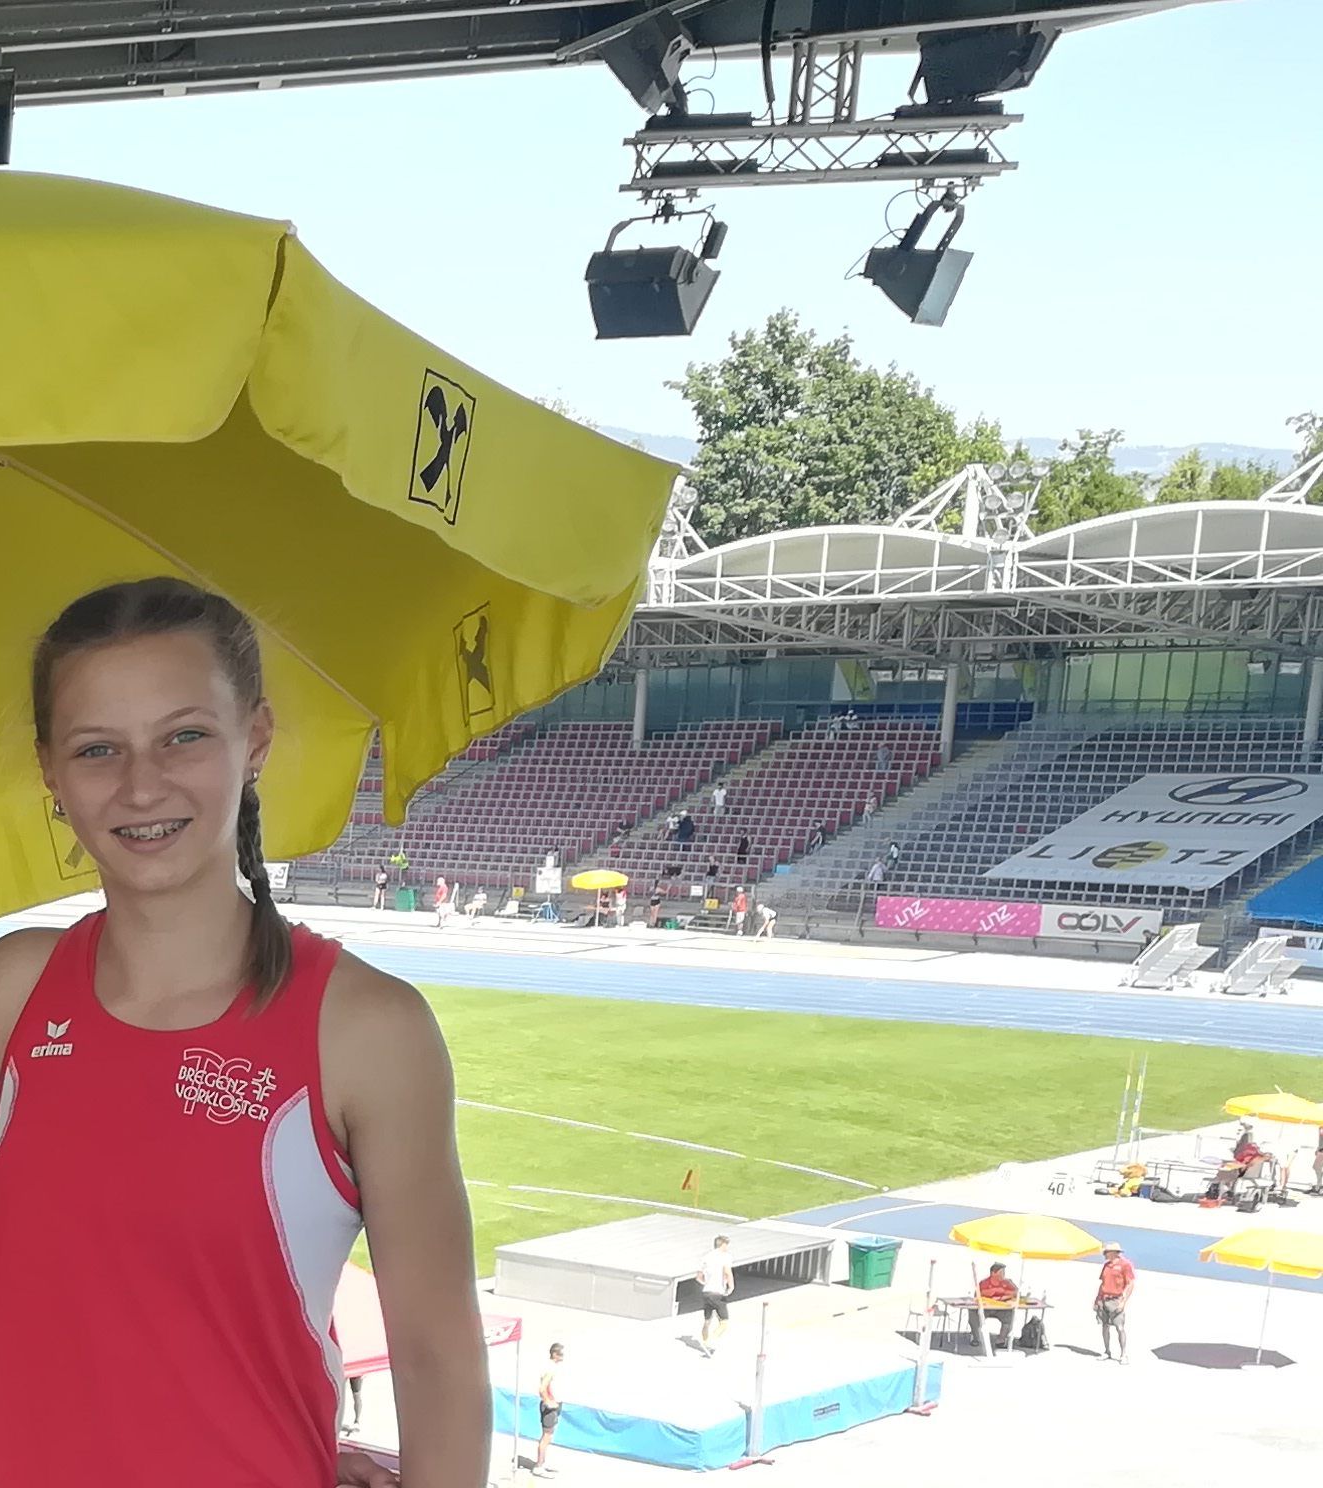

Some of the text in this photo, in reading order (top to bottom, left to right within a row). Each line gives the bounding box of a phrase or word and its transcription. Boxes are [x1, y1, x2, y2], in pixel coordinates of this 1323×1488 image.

[1100, 809, 1295, 826] HYUNDAI
[30, 1042, 74, 1058] erima
[178, 1065, 248, 1096] BREGENZ
[175, 1083, 269, 1122] VORKLOSTER
[1047, 1182, 1066, 1195] 40
